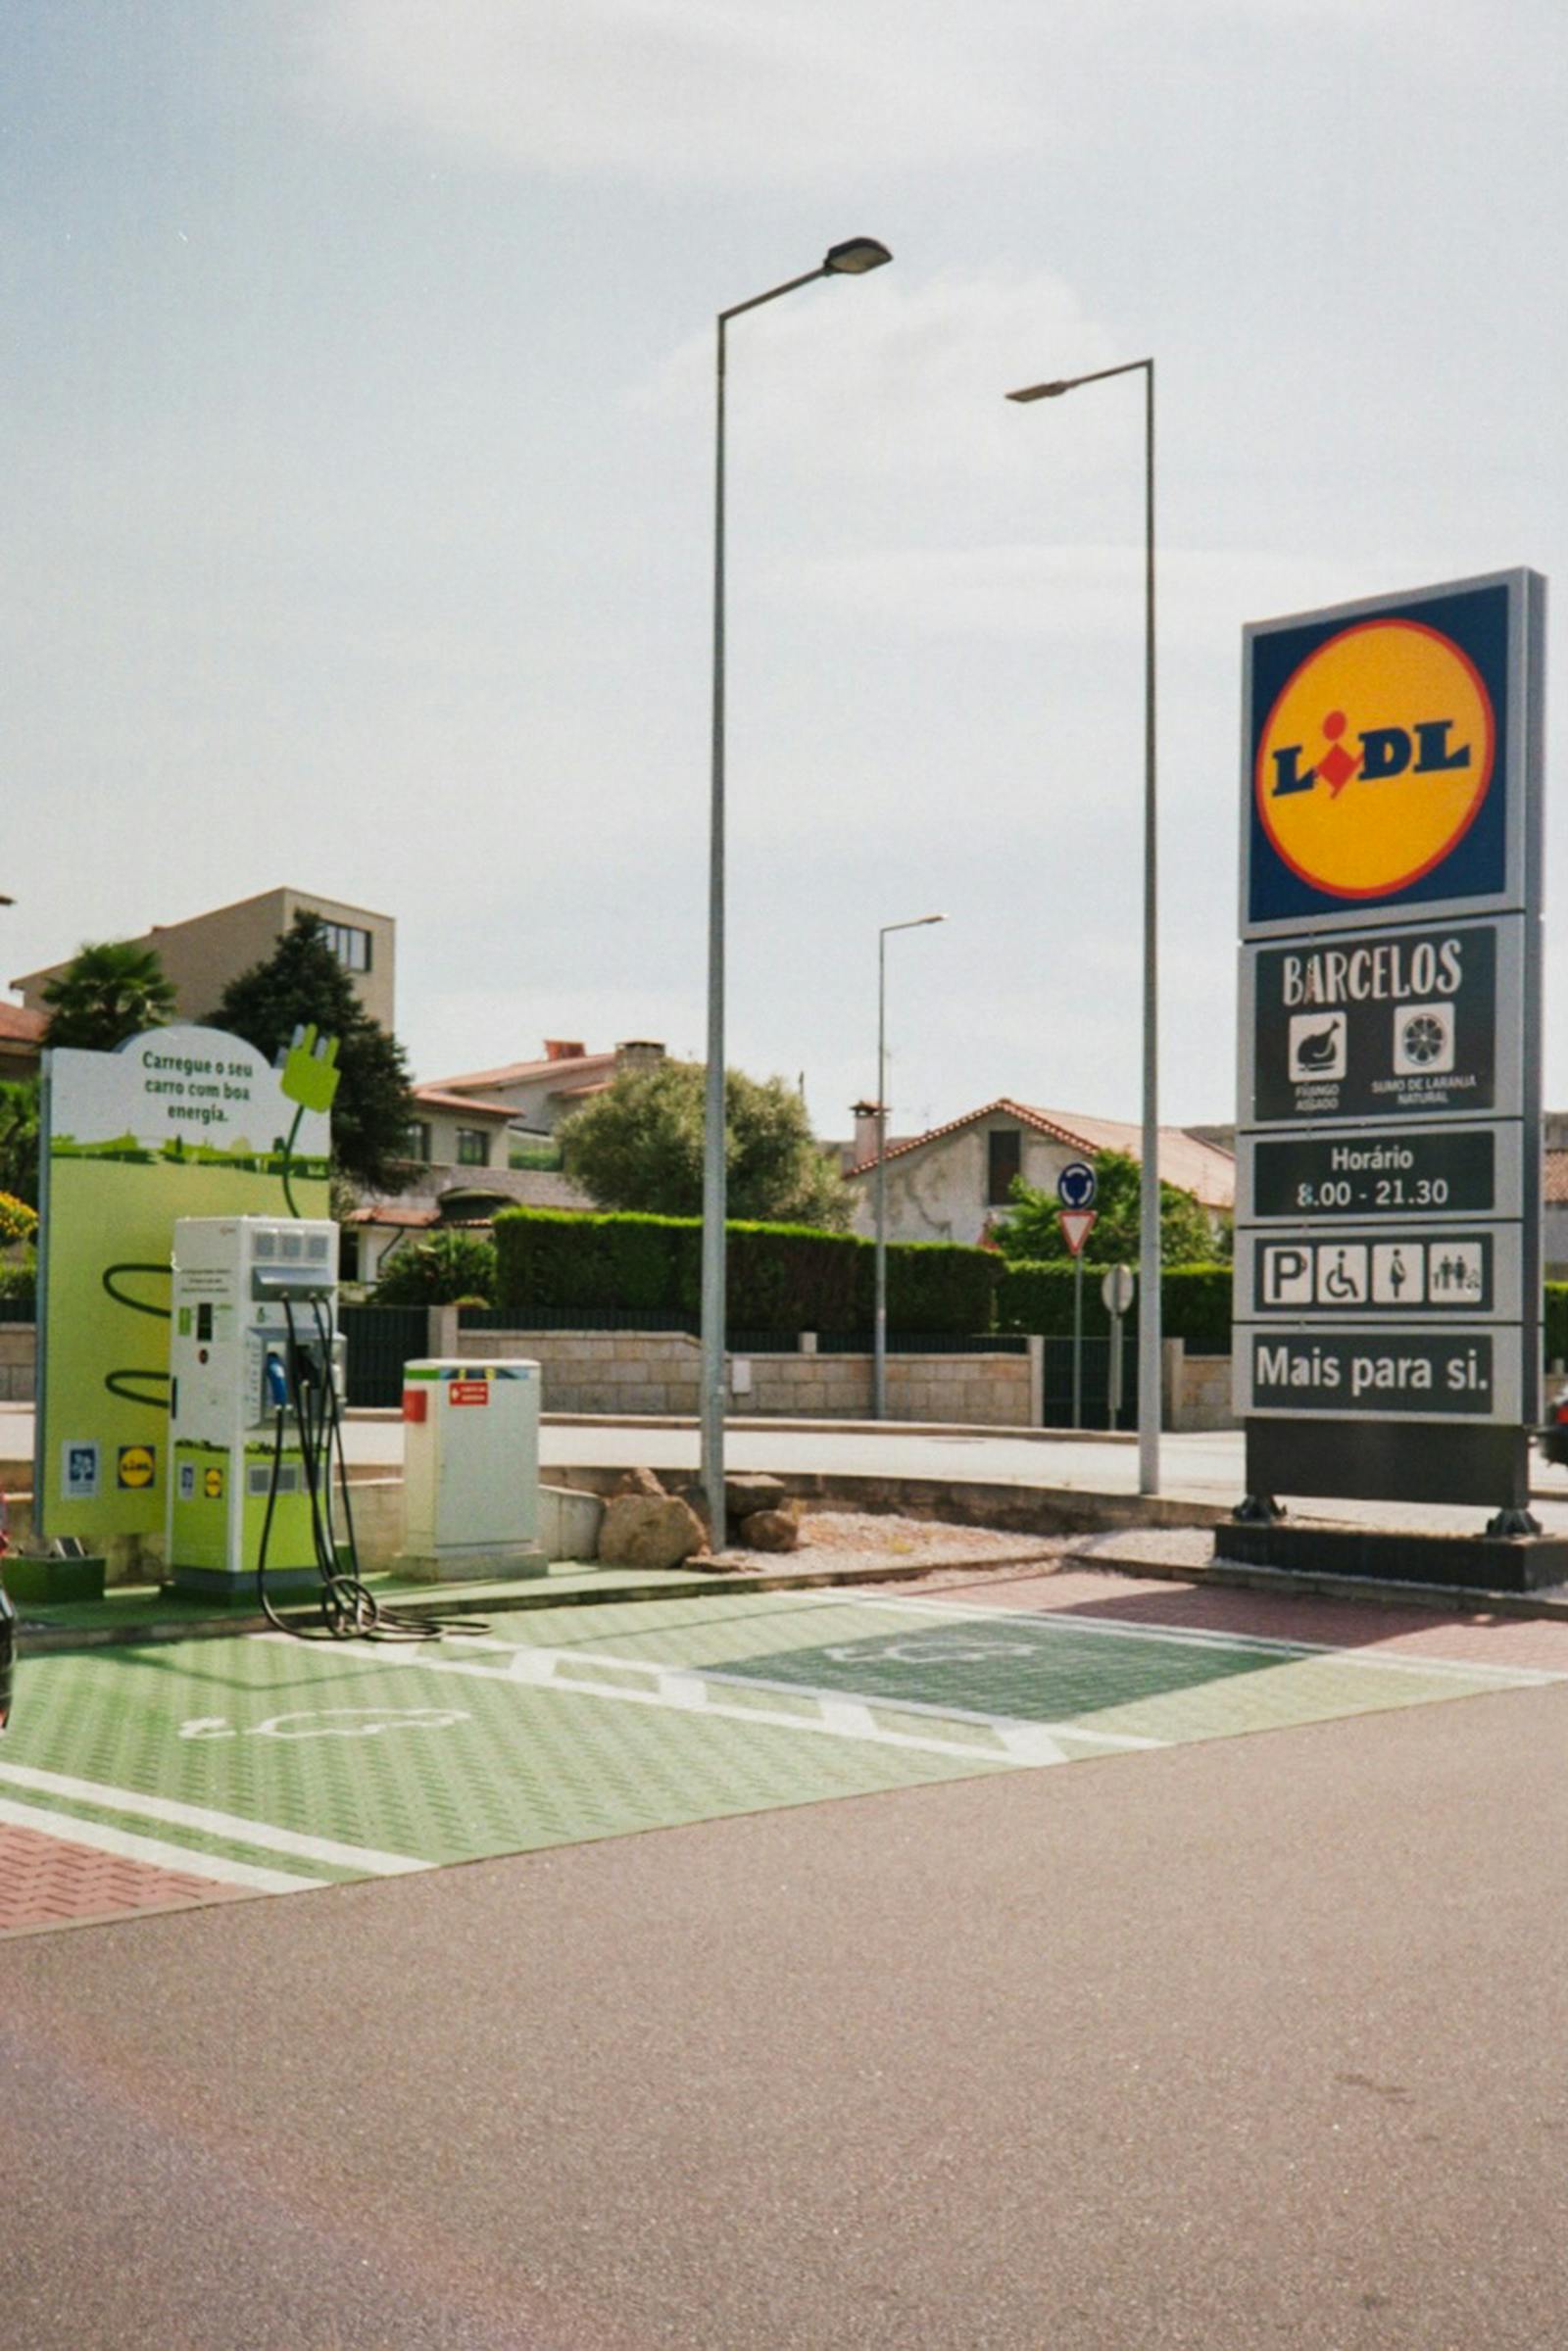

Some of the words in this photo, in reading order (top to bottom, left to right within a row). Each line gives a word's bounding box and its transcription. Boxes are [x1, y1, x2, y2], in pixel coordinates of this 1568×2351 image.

[1283, 939, 1462, 1006] BARCELOS
[142, 1051, 212, 1076] Carregue
[215, 1061, 224, 1075] o
[227, 1062, 253, 1077] seu
[145, 1079, 184, 1096] carro
[188, 1083, 220, 1098] com
[223, 1082, 250, 1101] boa
[1331, 1144, 1414, 1171] Horário
[1297, 1180, 1351, 1207] 8.00
[1375, 1178, 1449, 1205] 21.30
[1255, 1346, 1341, 1388] Mais
[1351, 1356, 1433, 1397] para
[1446, 1348, 1489, 1391] si.
